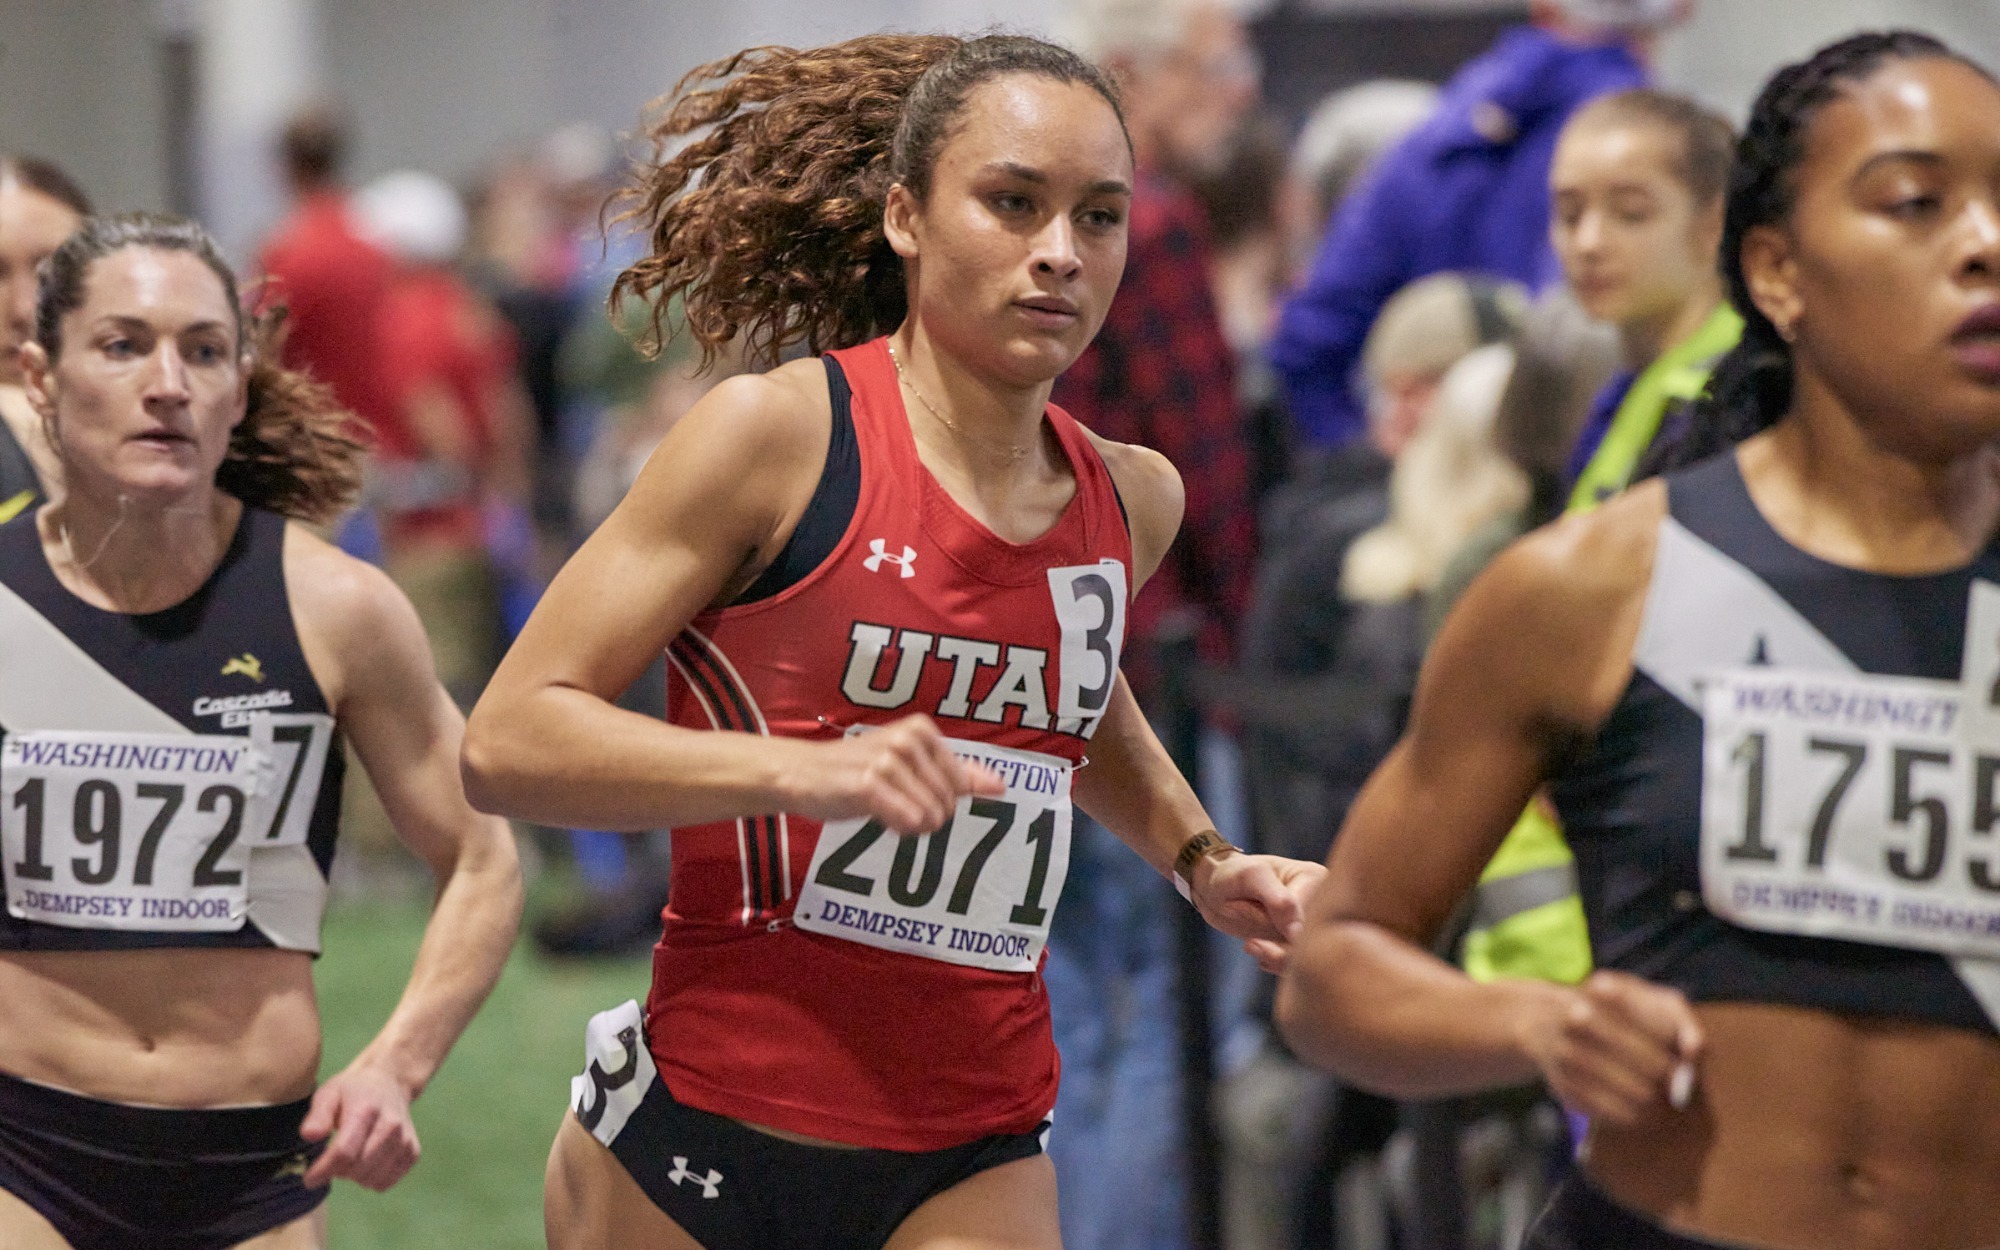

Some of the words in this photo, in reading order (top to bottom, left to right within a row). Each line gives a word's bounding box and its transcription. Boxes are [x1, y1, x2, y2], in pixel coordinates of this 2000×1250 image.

[840, 620, 1098, 741] UTA
[1071, 573, 1114, 710] 3
[20, 741, 241, 773] WASHINGTON
[192, 689, 293, 716] Cascadia
[13, 777, 247, 888] 1972
[266, 724, 314, 840] 7
[1724, 733, 2000, 892] 1755
[24, 889, 133, 917] DEMPSEY
[141, 898, 231, 919] INDOOR
[814, 796, 1056, 927] 2071
[820, 900, 944, 946] DEMPSEY
[947, 927, 1030, 957] INDOOR
